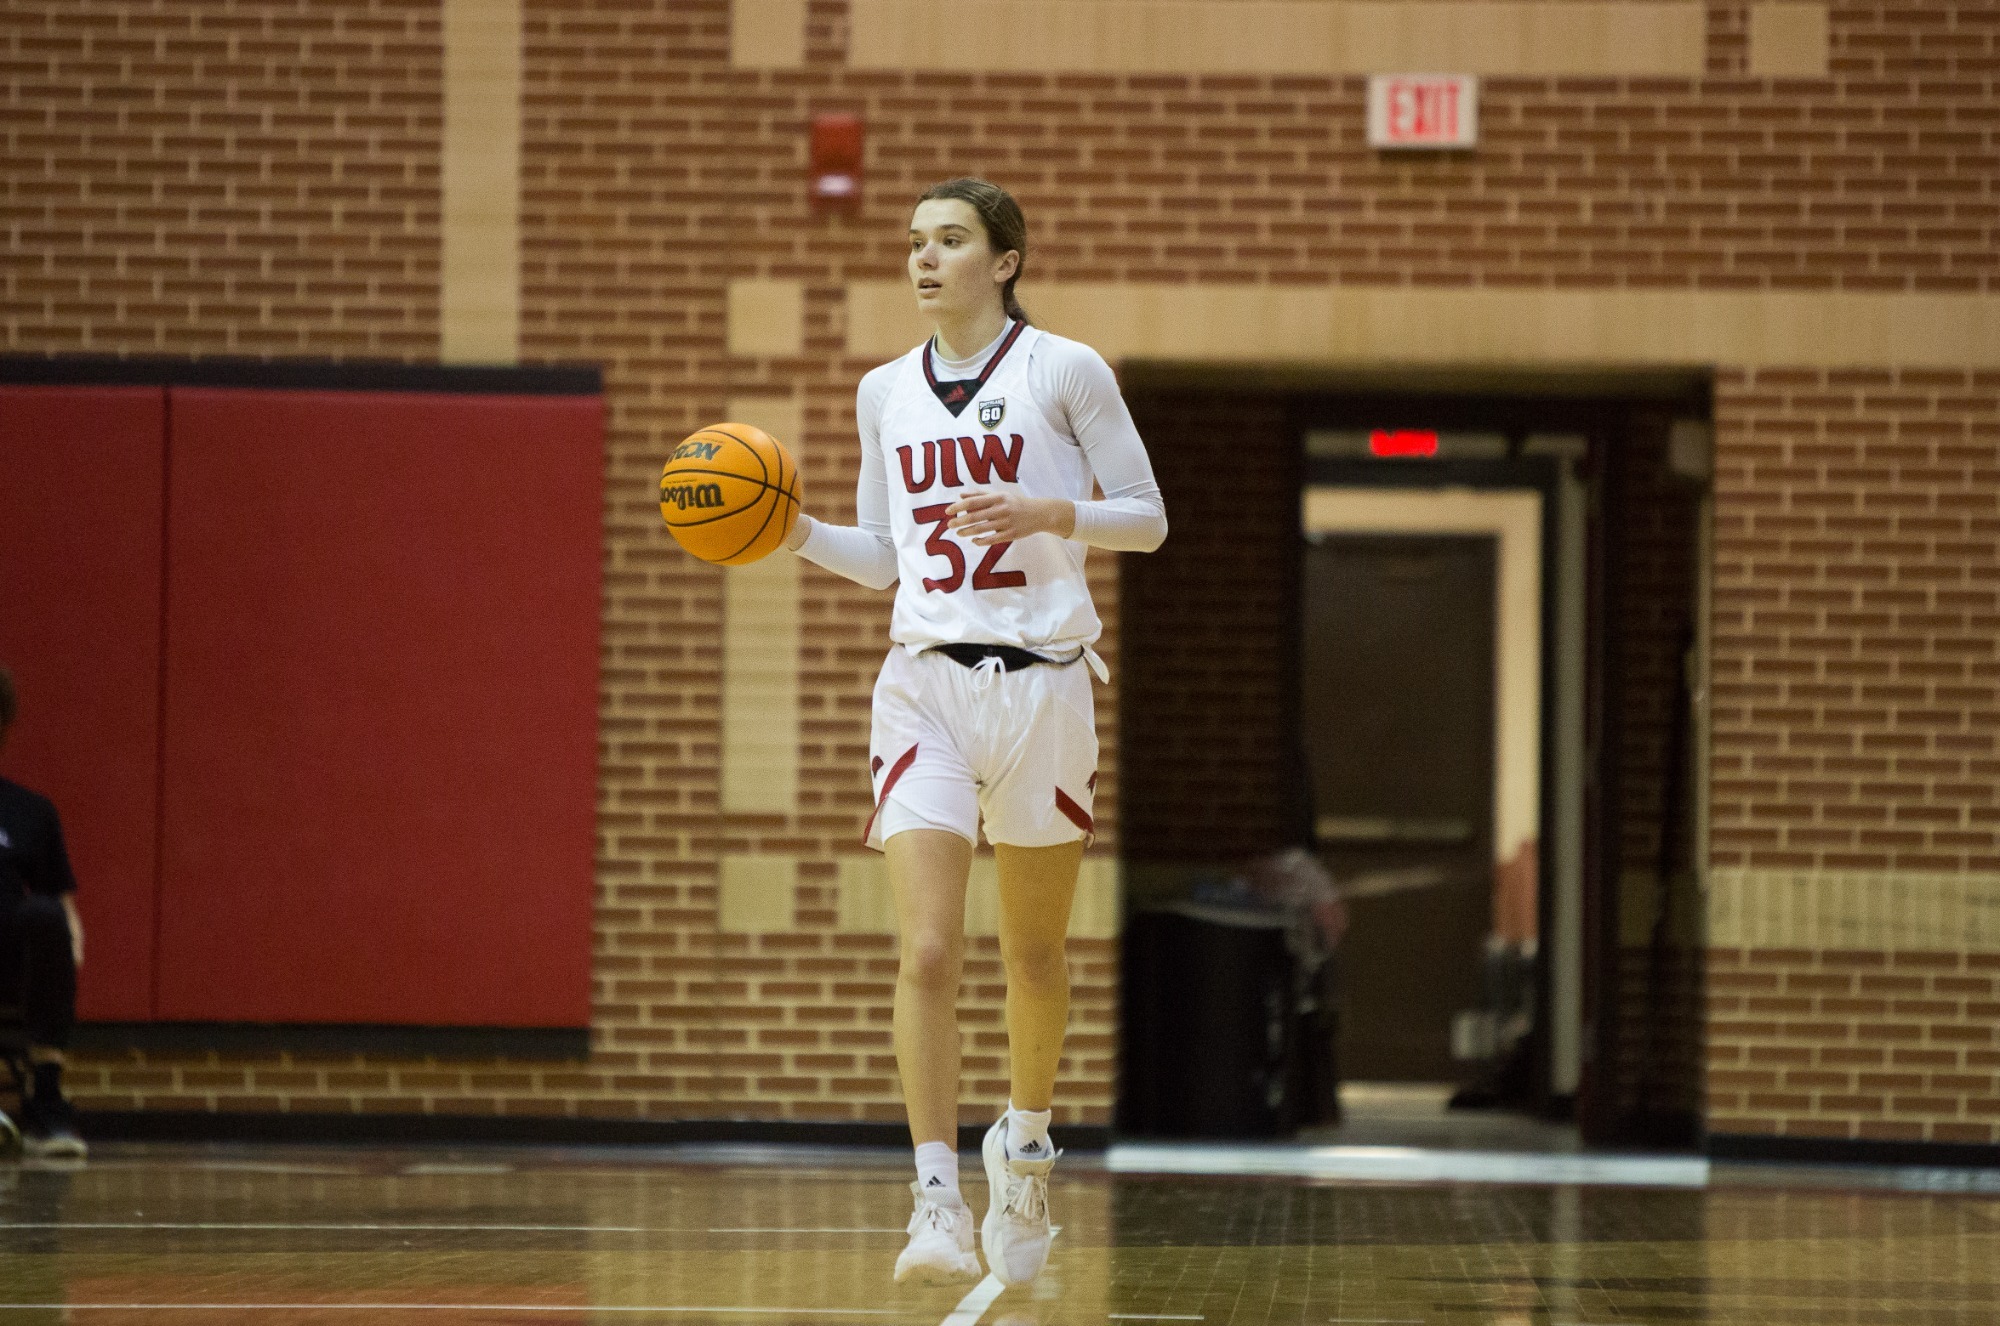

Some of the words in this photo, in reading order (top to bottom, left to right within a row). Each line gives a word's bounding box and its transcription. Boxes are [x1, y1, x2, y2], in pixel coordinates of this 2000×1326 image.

[1386, 81, 1460, 140] EXIT
[981, 406, 1001, 422] 60
[667, 441, 722, 465] NCA
[896, 433, 1025, 494] UIW
[912, 502, 1027, 594] 32
